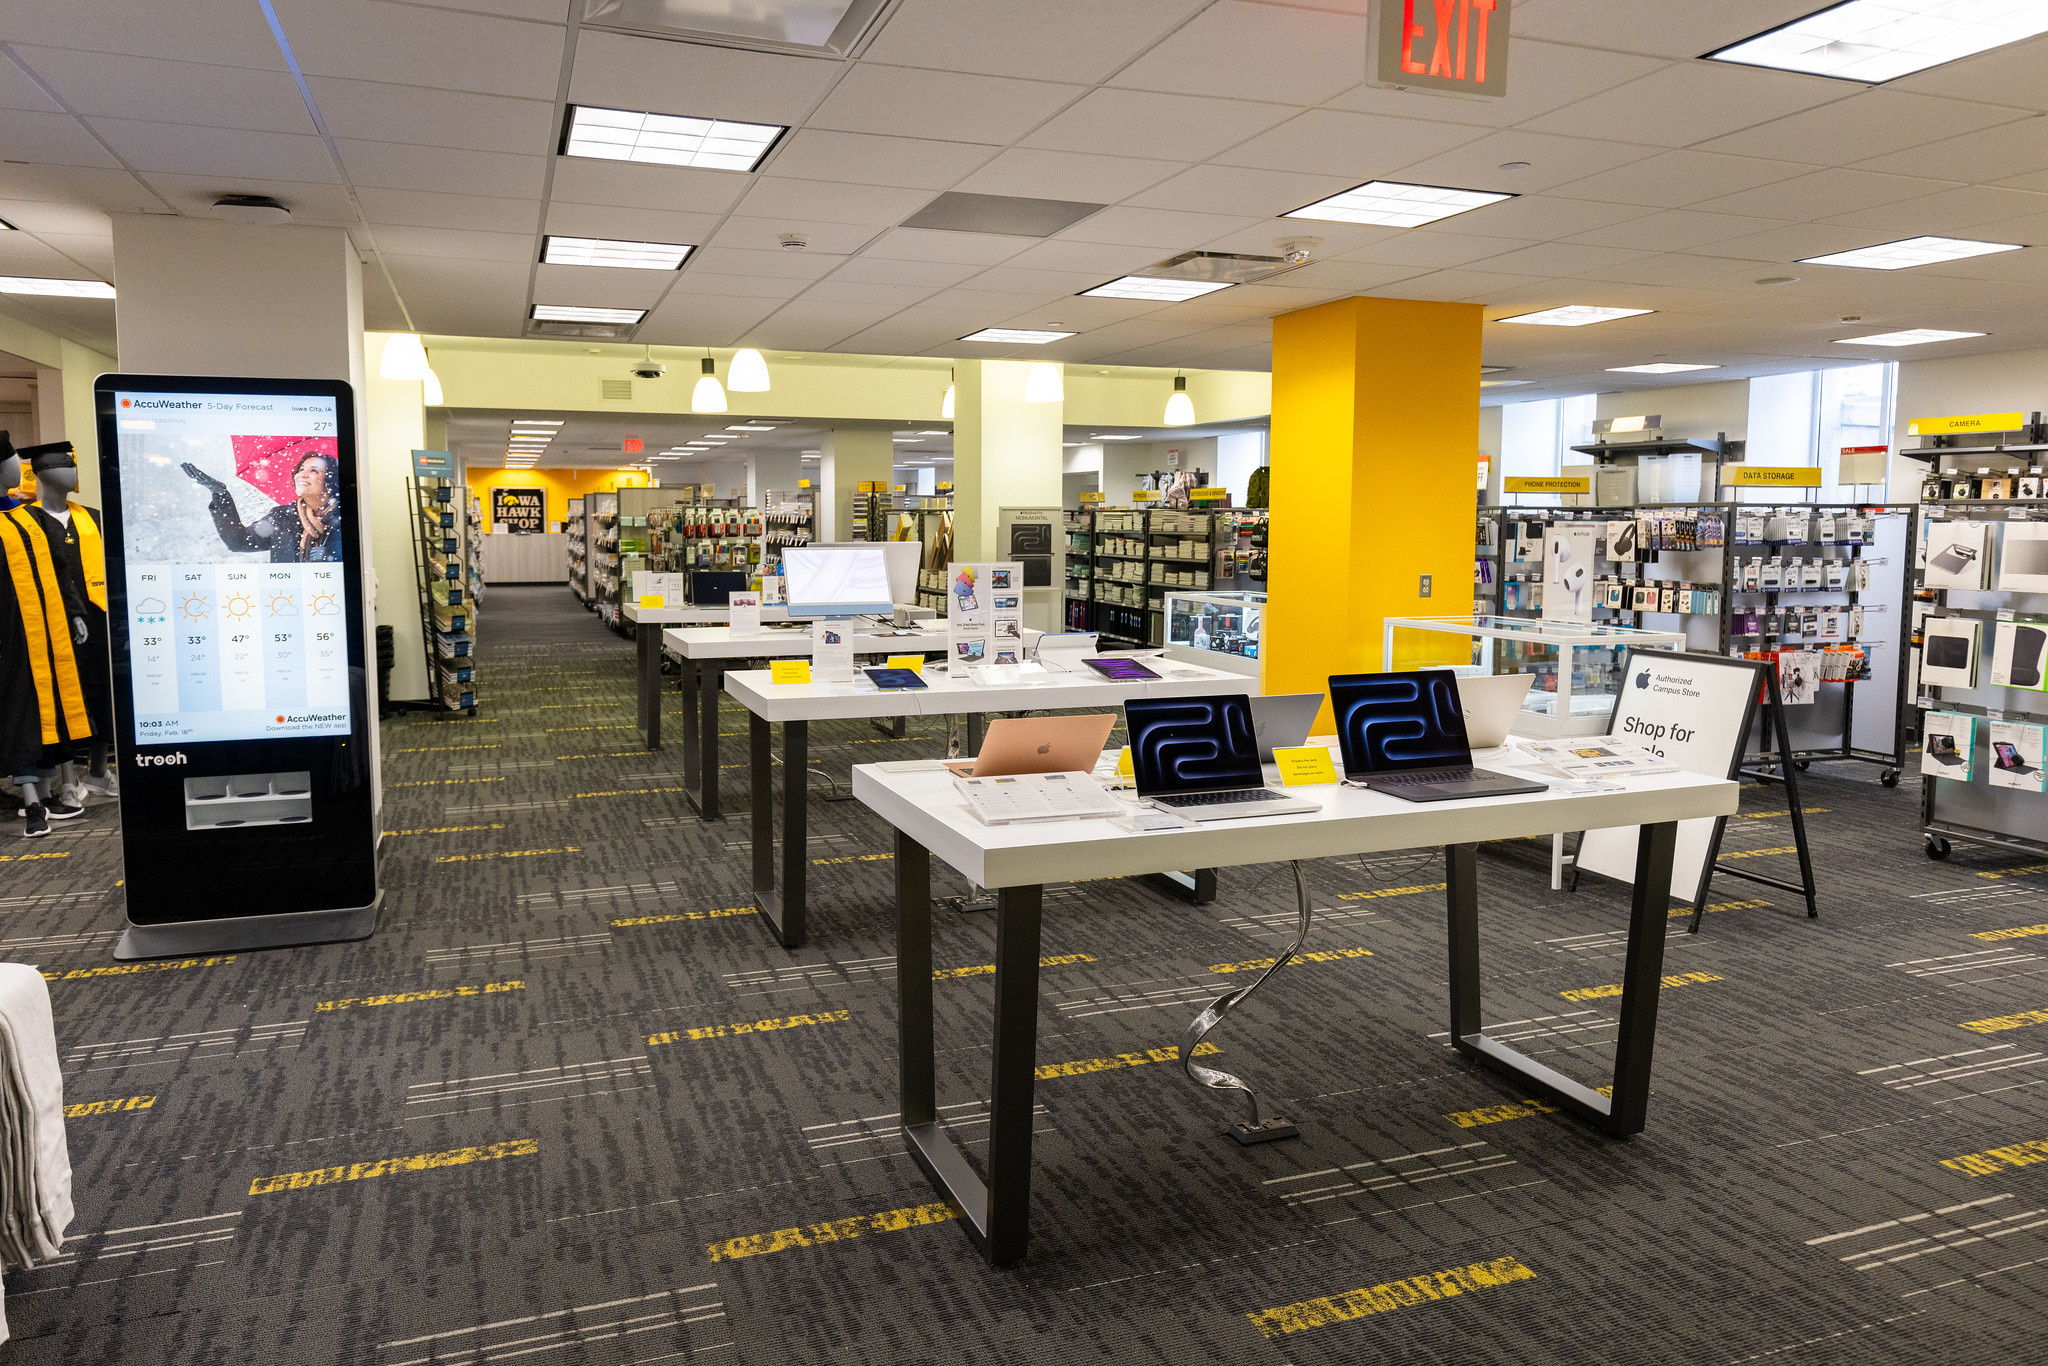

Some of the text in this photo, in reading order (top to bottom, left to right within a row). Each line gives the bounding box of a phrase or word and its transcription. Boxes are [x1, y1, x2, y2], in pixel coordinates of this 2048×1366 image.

[1401, 0, 1496, 83] EXIT
[134, 400, 274, 411] AccuWeather 5-Day Forecast
[1949, 420, 1981, 428] CAMERA
[1743, 472, 1795, 480] DATA STORAGE
[496, 507, 542, 518] HAWK
[1655, 674, 1693, 686] Authorized
[1653, 684, 1701, 697] Campus Store
[287, 713, 346, 723] AccuWeather
[139, 720, 163, 728] 10:03
[1623, 716, 1695, 743] Shop for
[135, 751, 188, 767] trooh
